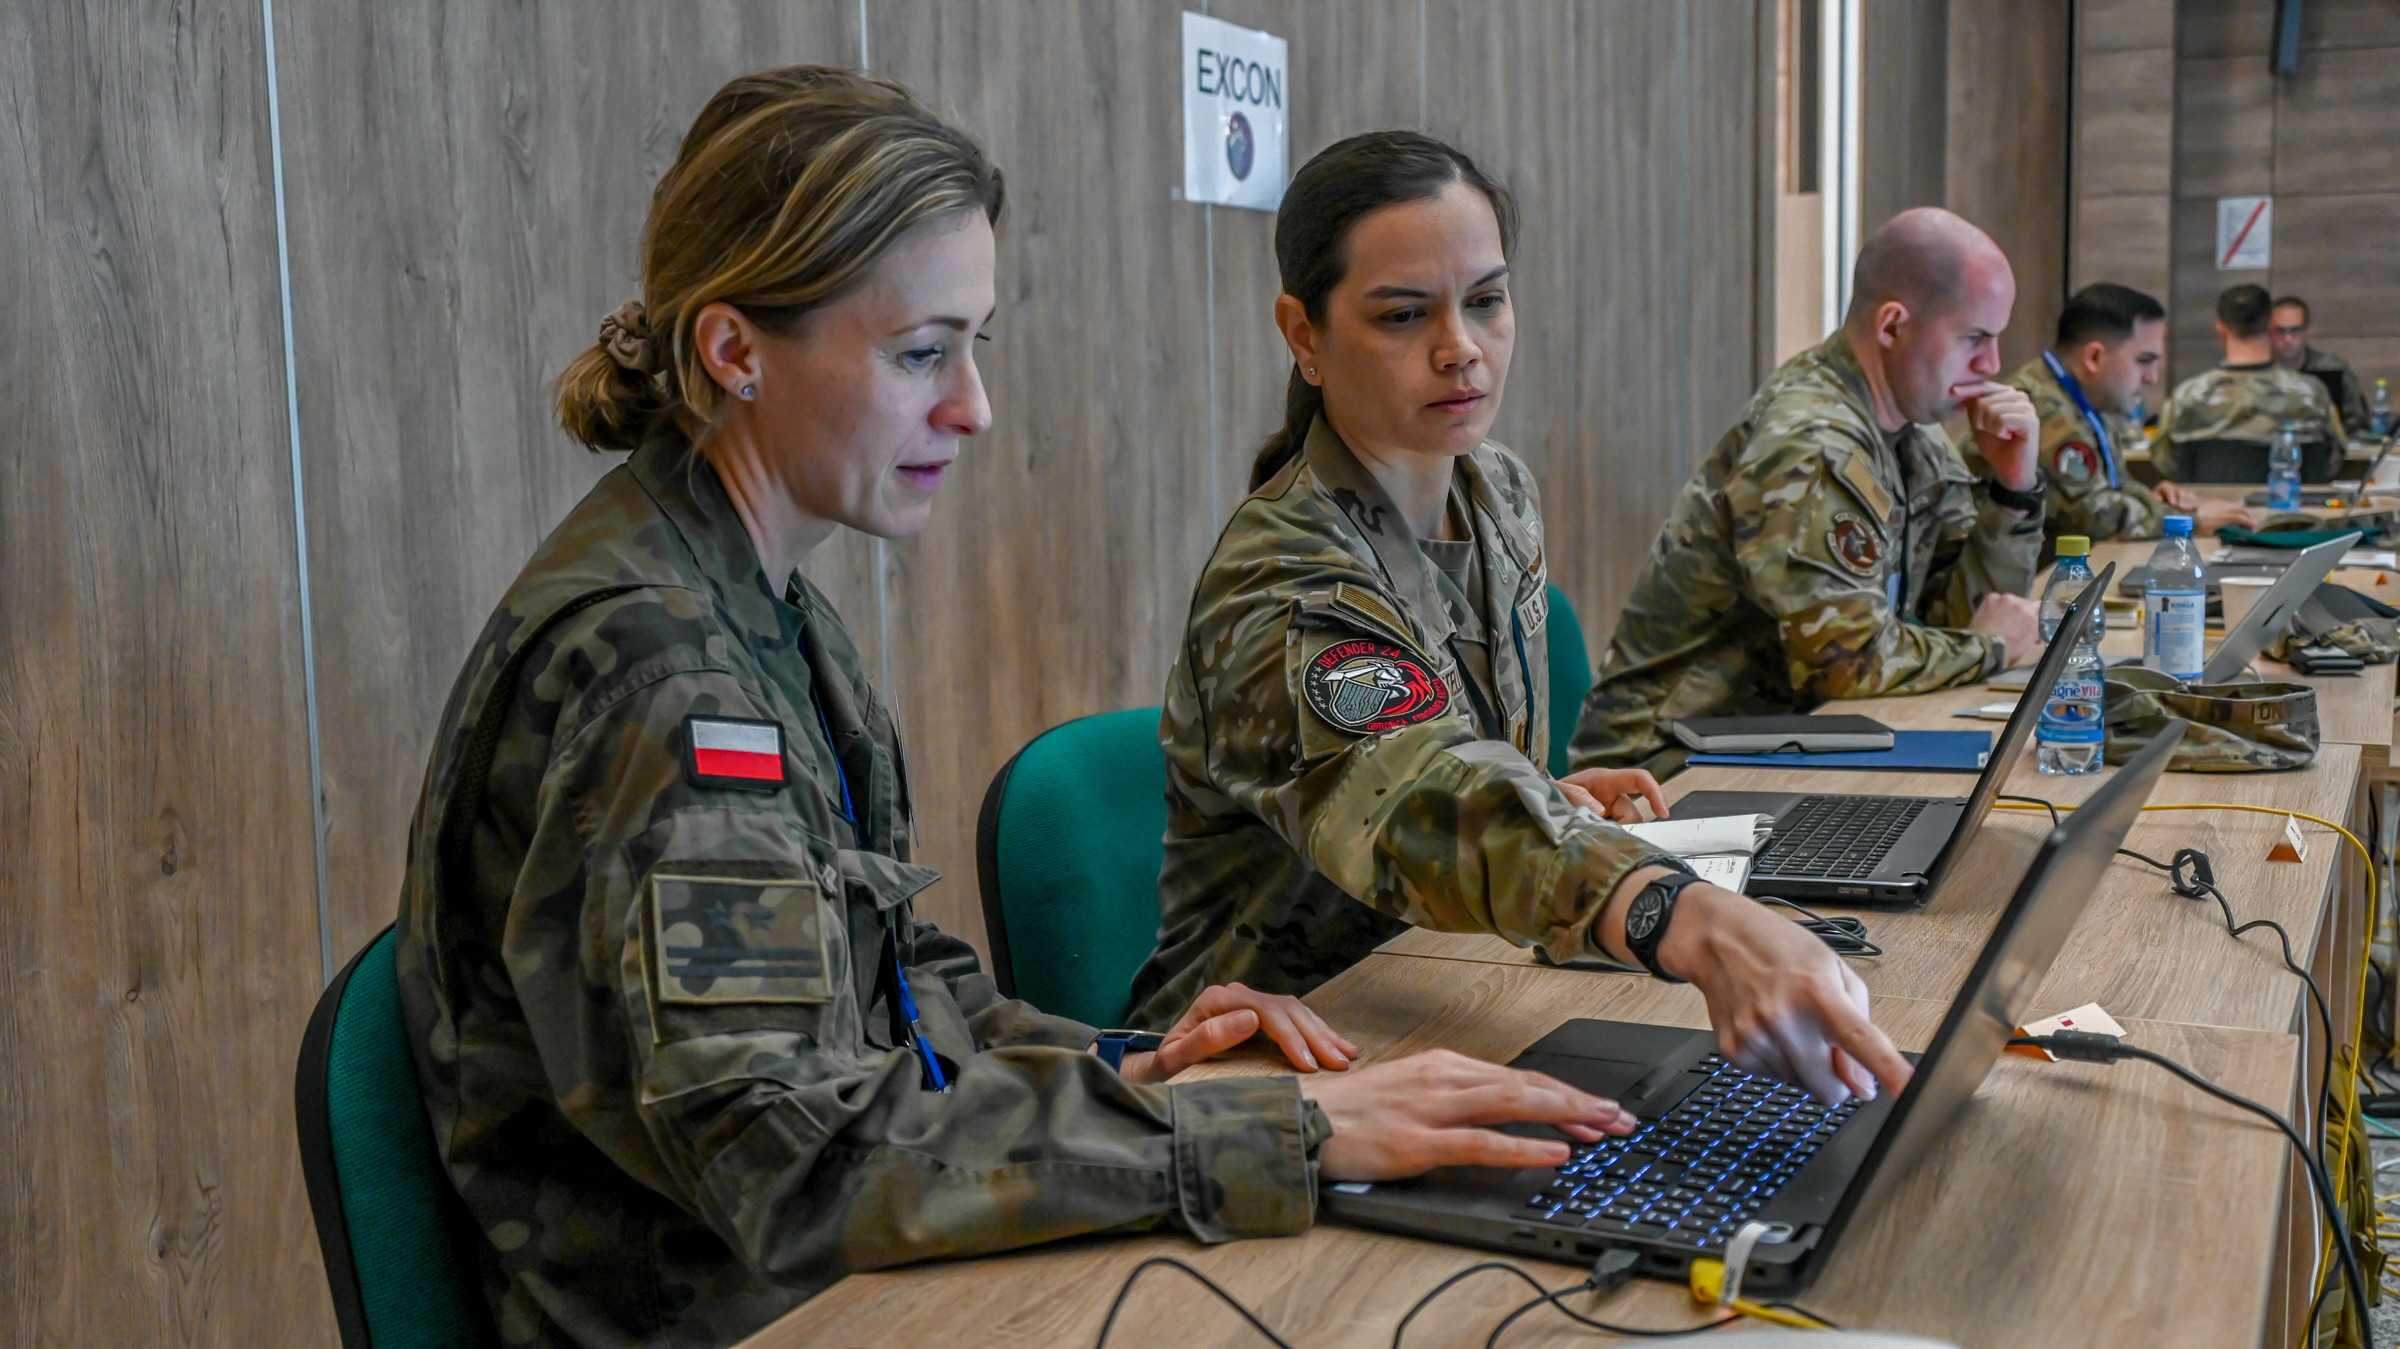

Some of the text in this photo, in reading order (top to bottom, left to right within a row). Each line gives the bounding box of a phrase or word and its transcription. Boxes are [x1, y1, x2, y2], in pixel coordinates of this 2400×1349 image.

[1198, 49, 1281, 109] EXCON
[1317, 642, 1402, 669] DEFENDER 24
